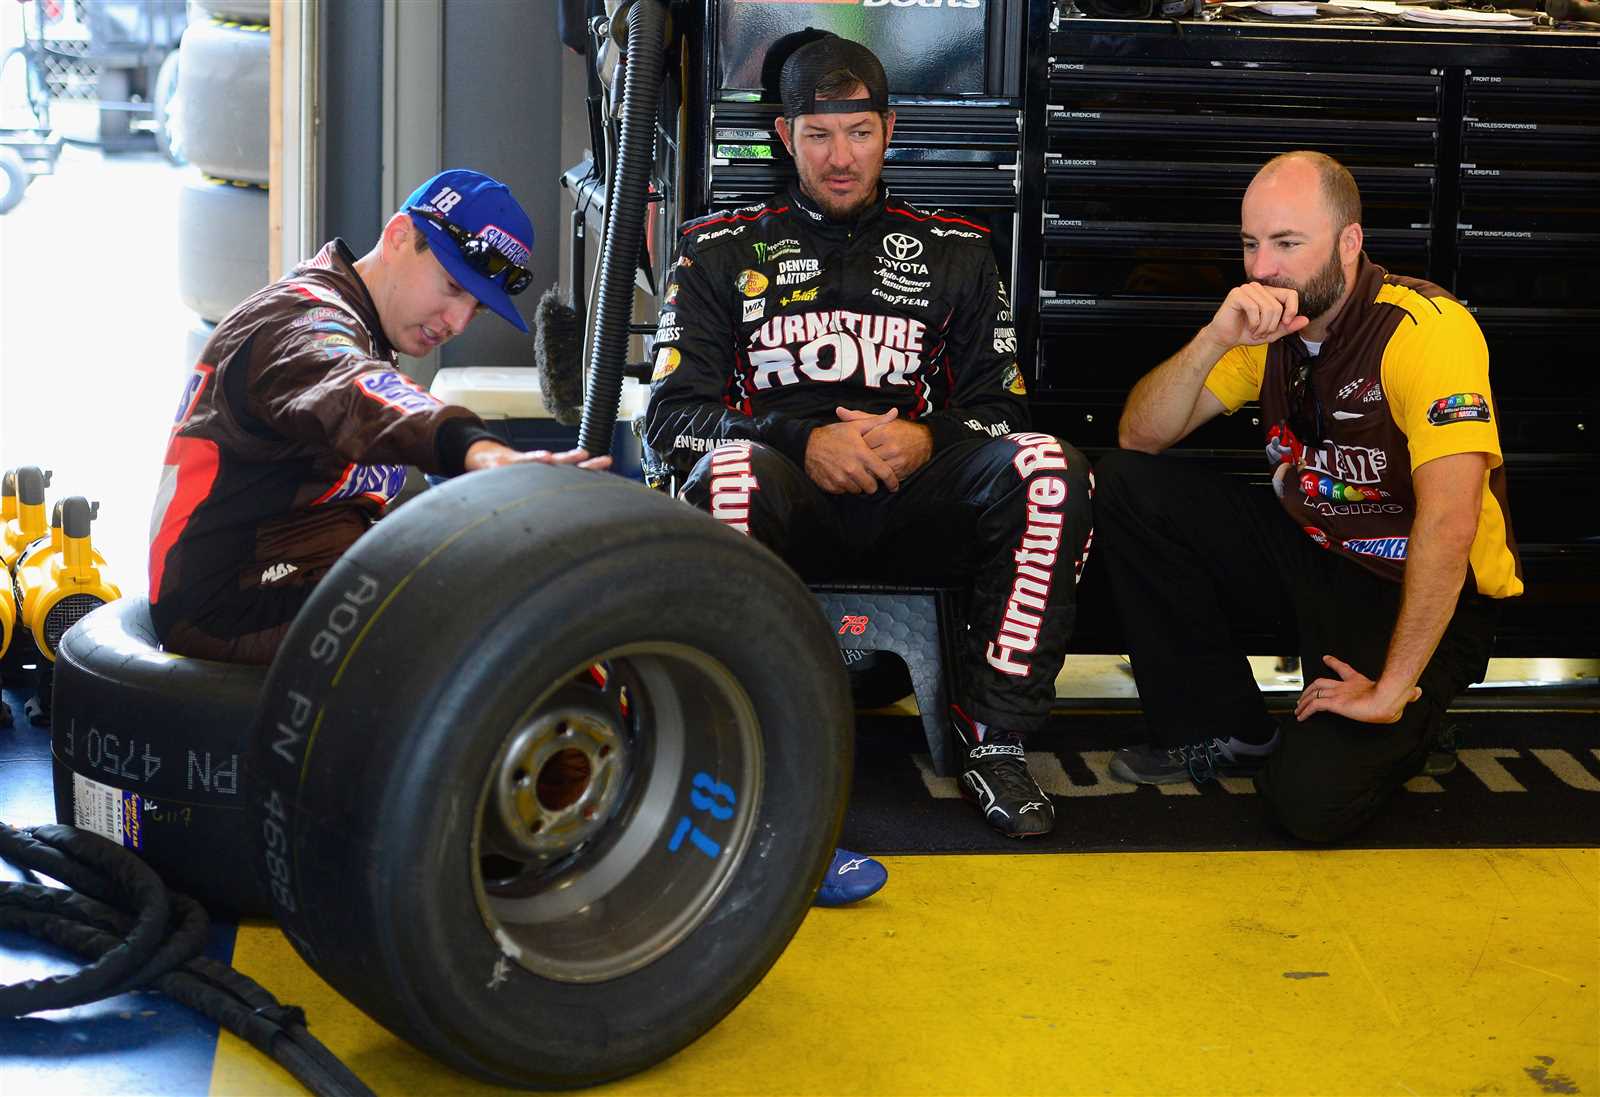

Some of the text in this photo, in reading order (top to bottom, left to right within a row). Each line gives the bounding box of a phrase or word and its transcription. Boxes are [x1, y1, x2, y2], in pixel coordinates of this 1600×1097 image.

[430, 186, 462, 213] 18
[779, 259, 819, 273] DENVER
[875, 255, 929, 275] TOYOTA
[776, 270, 822, 286] MATTRESS
[873, 268, 932, 288] Auto-Owners
[881, 278, 923, 293] Insurance
[745, 301, 763, 314] WIX
[872, 288, 930, 307] GOODYEAR
[986, 476, 1068, 677] Furniture
[838, 615, 869, 635] 78
[272, 689, 313, 764] PN
[87, 727, 162, 782] 4750
[187, 749, 239, 795] PN
[667, 772, 737, 859] 78
